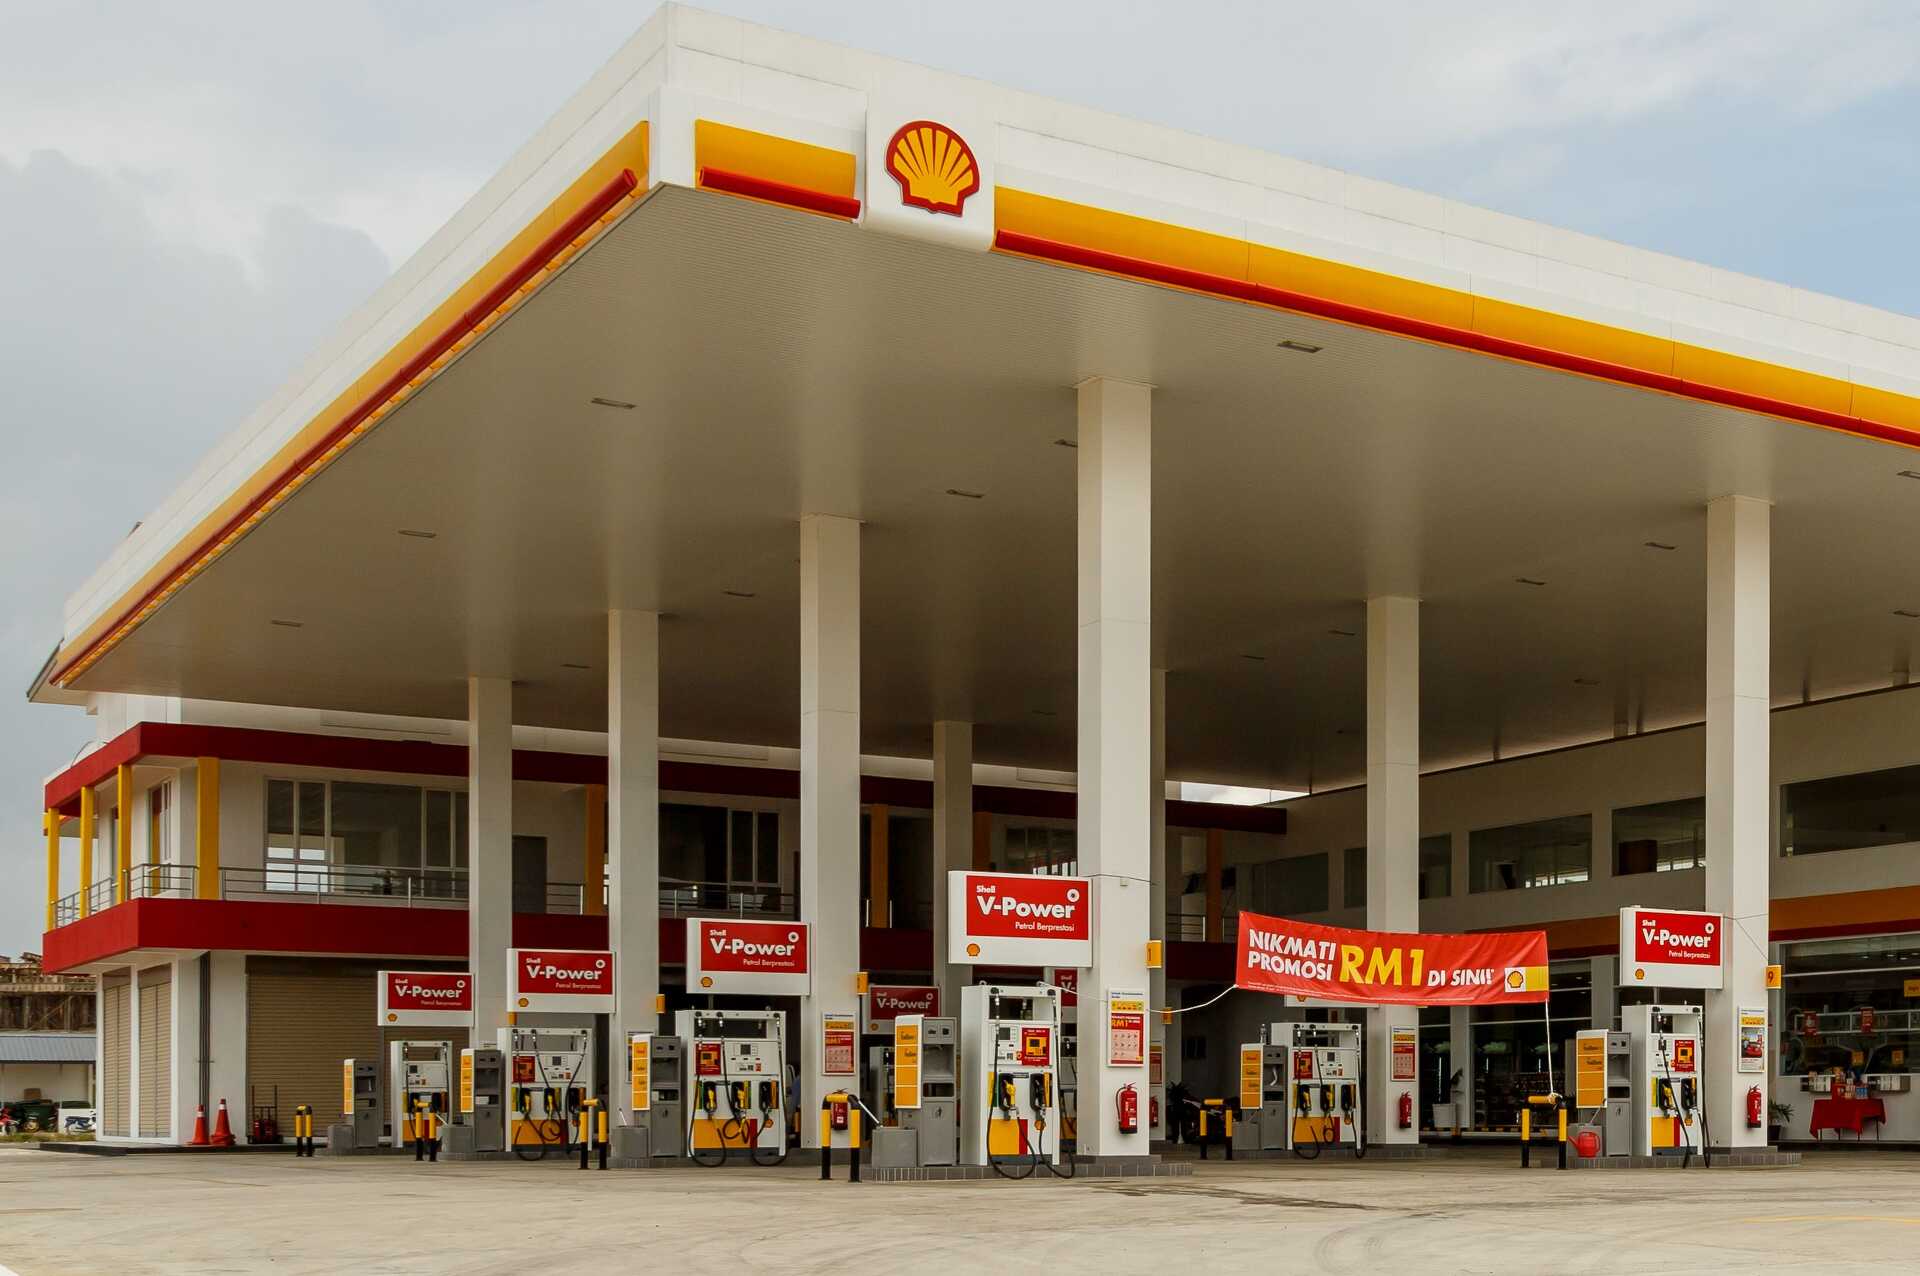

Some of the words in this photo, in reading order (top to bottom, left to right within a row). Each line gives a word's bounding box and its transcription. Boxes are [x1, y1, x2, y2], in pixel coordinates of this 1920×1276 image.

[976, 885, 996, 894] Shell
[976, 895, 1076, 919] V-Power
[1015, 921, 1036, 931] Petrol
[1036, 922, 1075, 933] Berprestasi
[1642, 919, 1656, 927] Shell
[709, 929, 727, 937] Shell
[1642, 928, 1711, 948] V-Power
[710, 938, 796, 956] V-Power
[1249, 928, 1337, 961] NIKMATI
[526, 965, 602, 980] V-Power
[1248, 950, 1333, 981] PROMOSI
[1339, 944, 1425, 986] RM1
[1427, 969, 1446, 987] DI
[395, 985, 462, 998] V-Power
[876, 998, 932, 1009] V-Power
